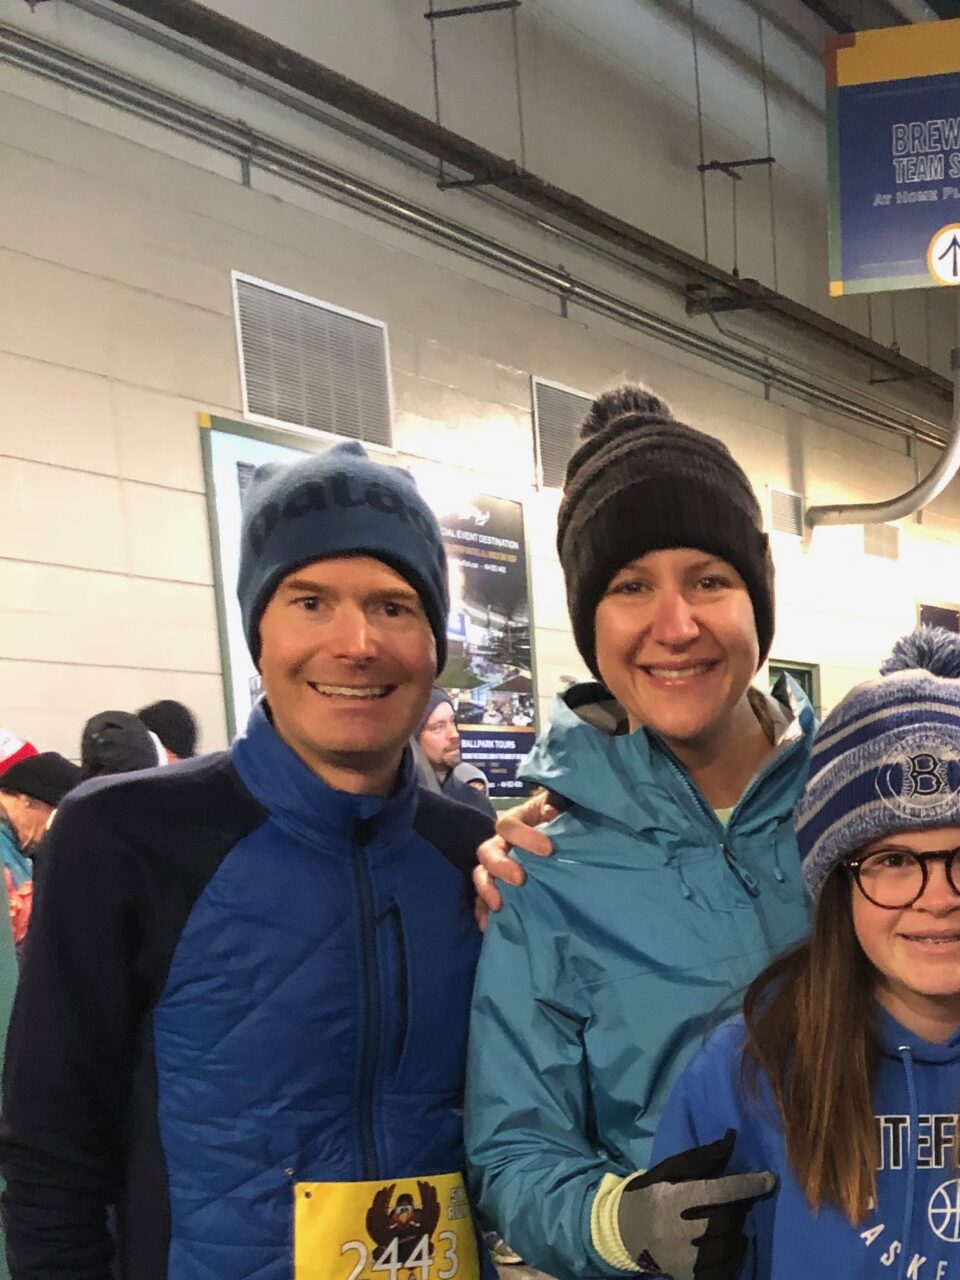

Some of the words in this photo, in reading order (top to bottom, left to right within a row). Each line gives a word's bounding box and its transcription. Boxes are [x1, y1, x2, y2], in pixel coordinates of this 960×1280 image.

[893, 154, 944, 183] TEAM
[456, 530, 478, 541] EVENT
[478, 534, 519, 550] DESTINATION
[461, 739, 493, 749] BALLPARK
[495, 740, 516, 749] TOURS
[907, 753, 945, 799] B
